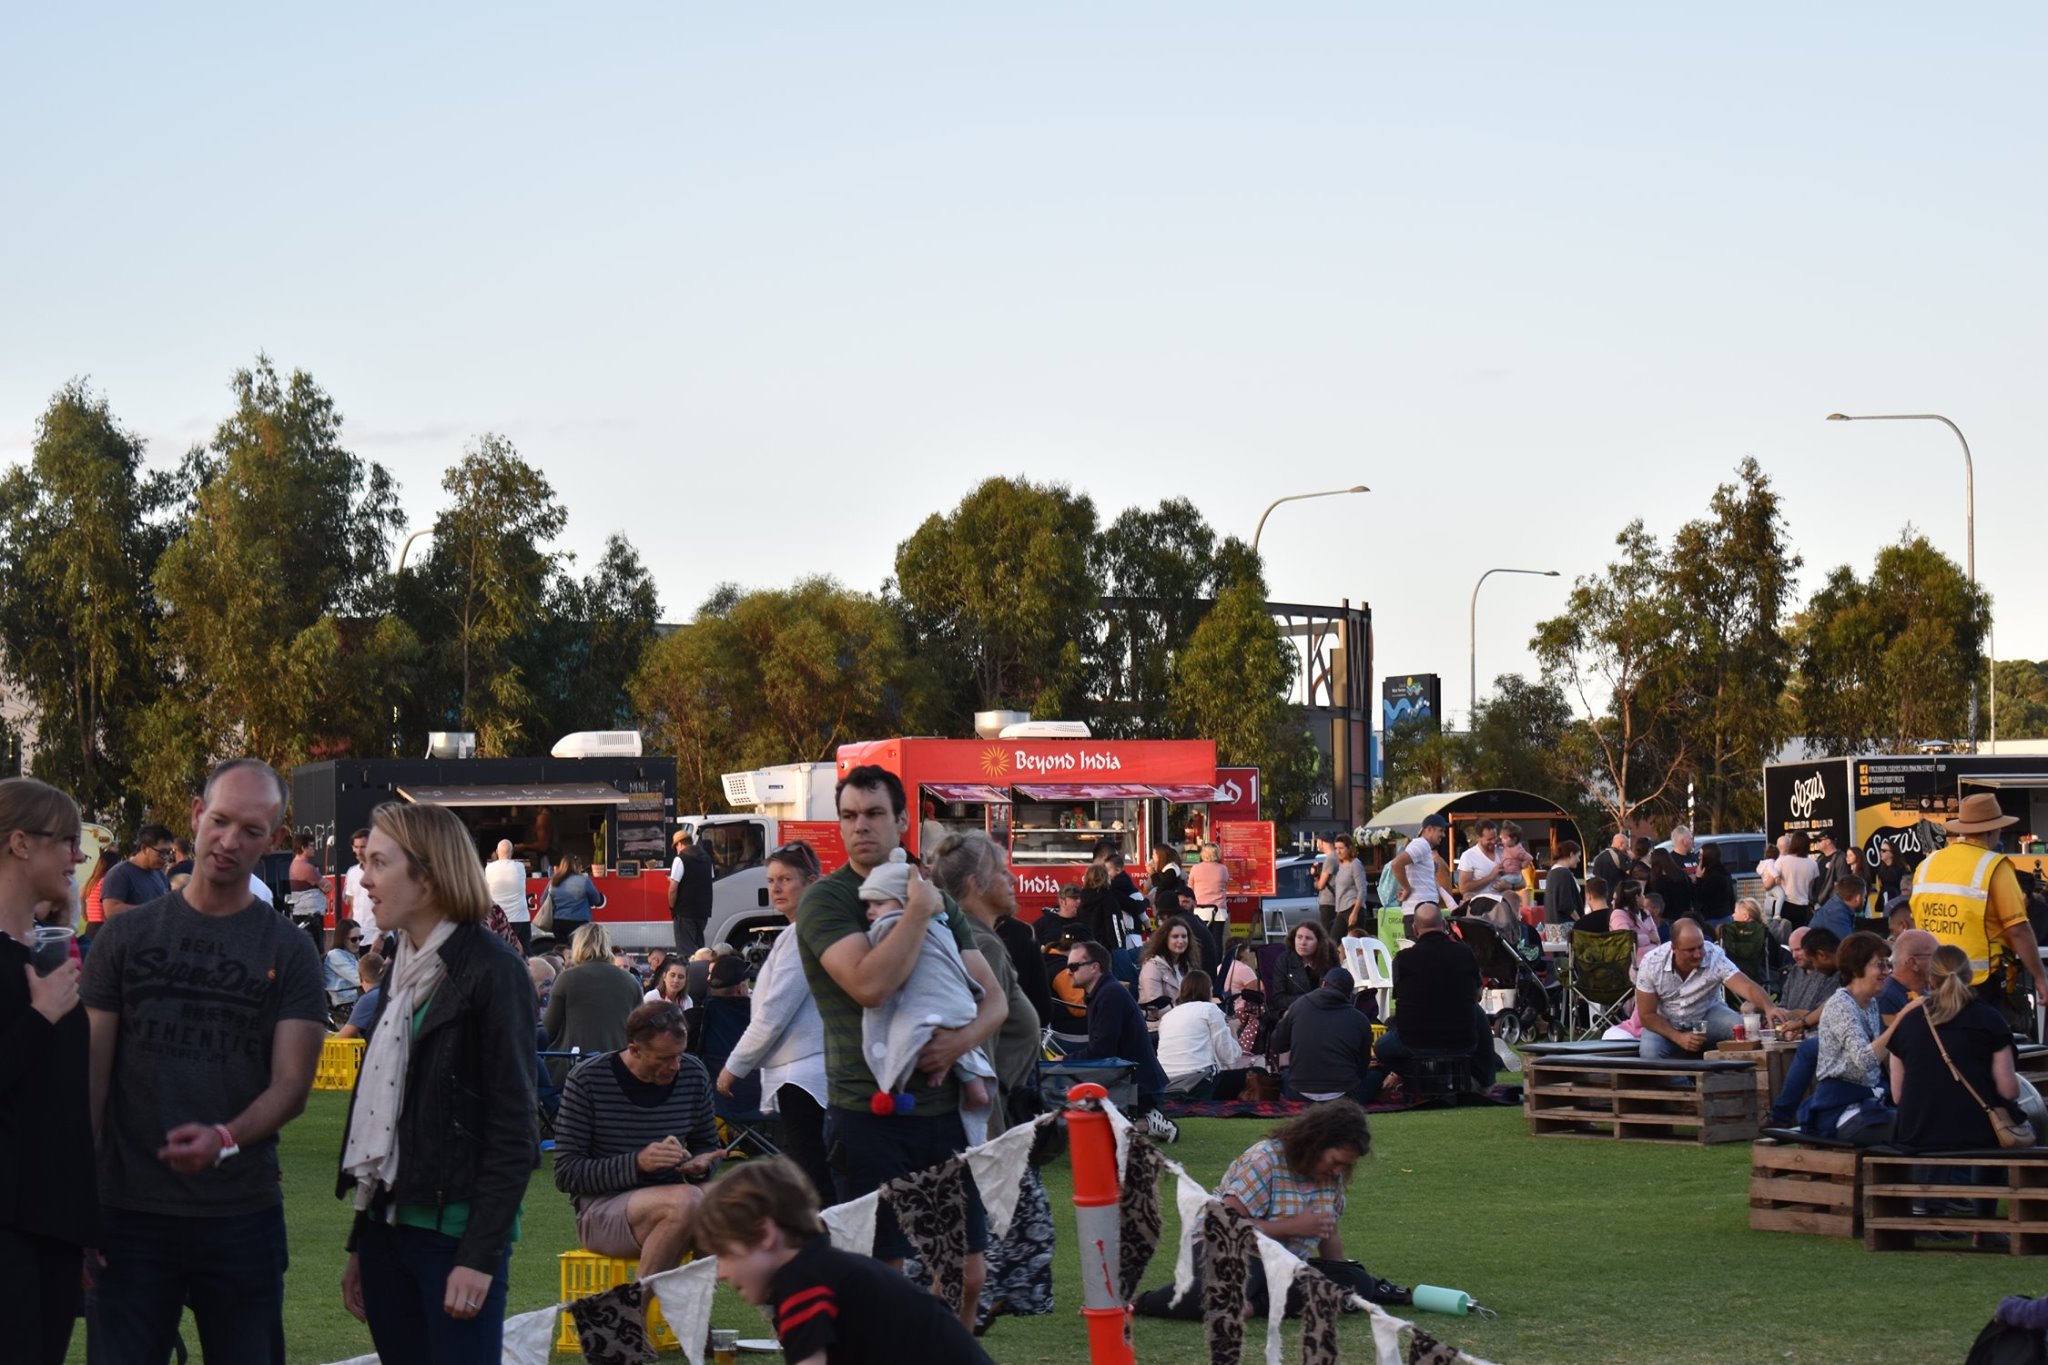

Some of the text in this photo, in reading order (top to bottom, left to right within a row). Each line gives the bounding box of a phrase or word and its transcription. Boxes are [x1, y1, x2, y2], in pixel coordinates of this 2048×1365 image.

[1015, 750, 1121, 775] Beyond India
[1790, 771, 1826, 818] Soza's
[1866, 828, 1921, 867] Sa's
[1018, 873, 1060, 894] India
[1921, 902, 1958, 918] WESLO
[179, 937, 227, 957] REAL
[125, 1018, 260, 1056] UTHENTIC
